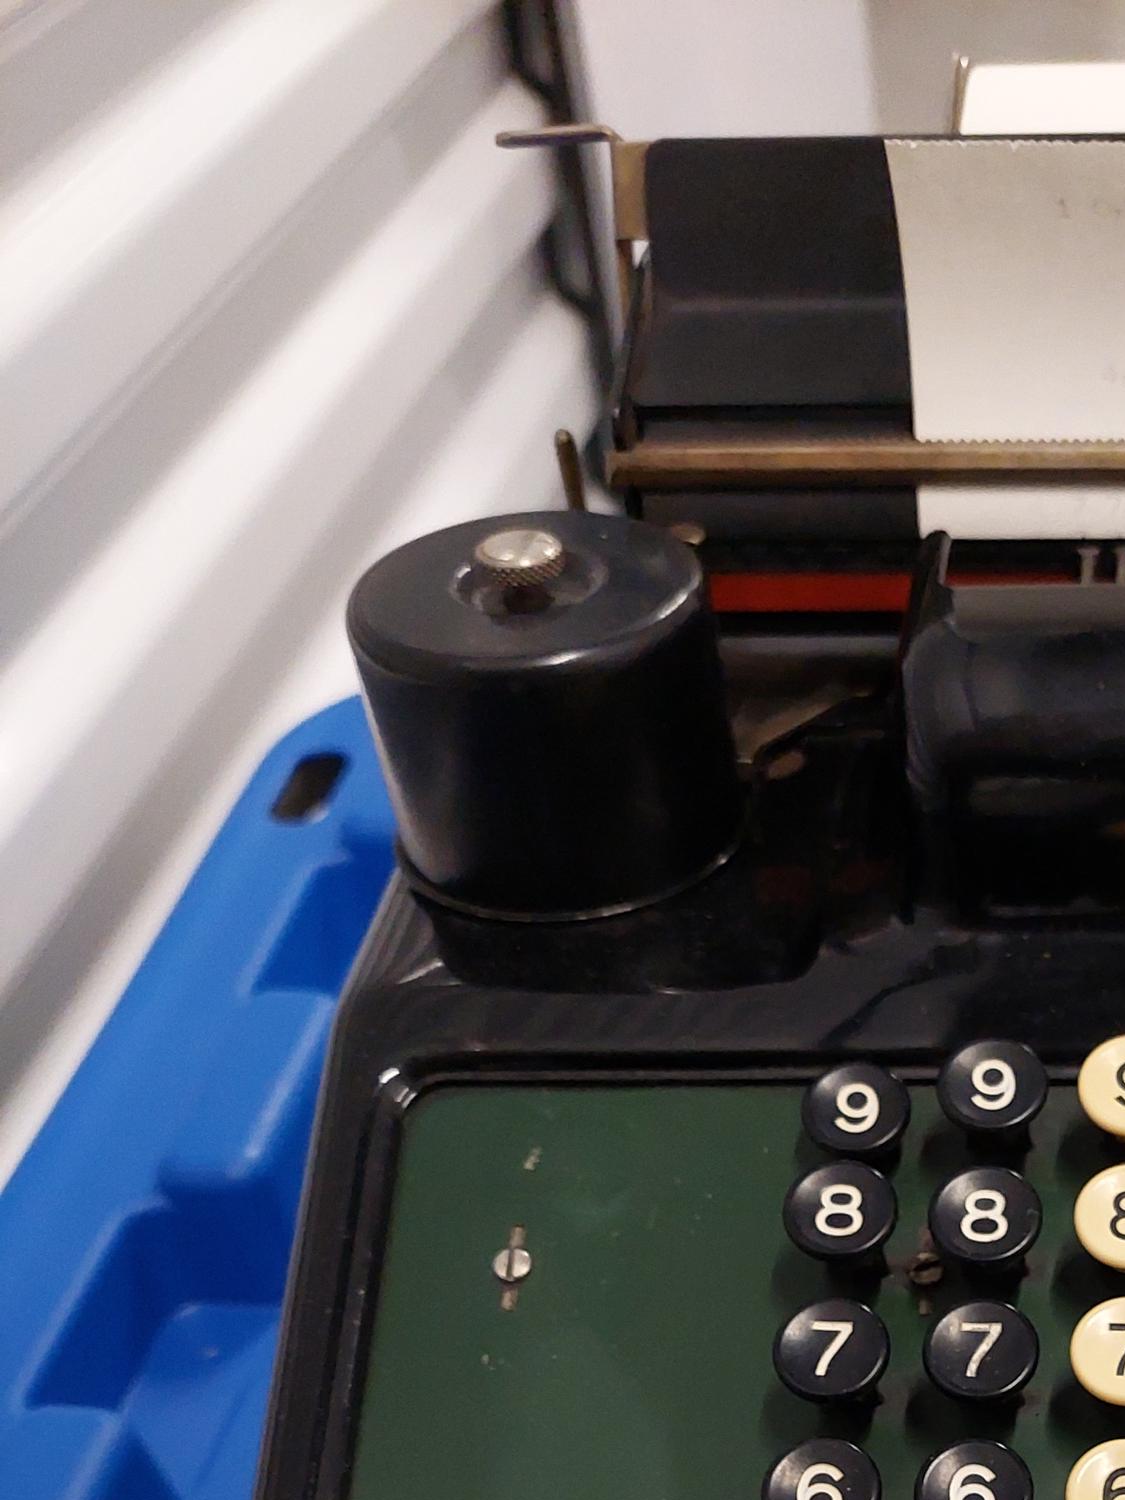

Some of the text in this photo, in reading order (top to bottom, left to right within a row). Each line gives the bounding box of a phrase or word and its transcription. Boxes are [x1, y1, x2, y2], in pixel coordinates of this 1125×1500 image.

[834, 1083, 879, 1134] 9
[970, 1059, 1016, 1111] 9
[814, 1184, 864, 1237] 8
[960, 1189, 1009, 1243] 8
[812, 1321, 853, 1377] 7
[962, 1322, 1003, 1378] 7
